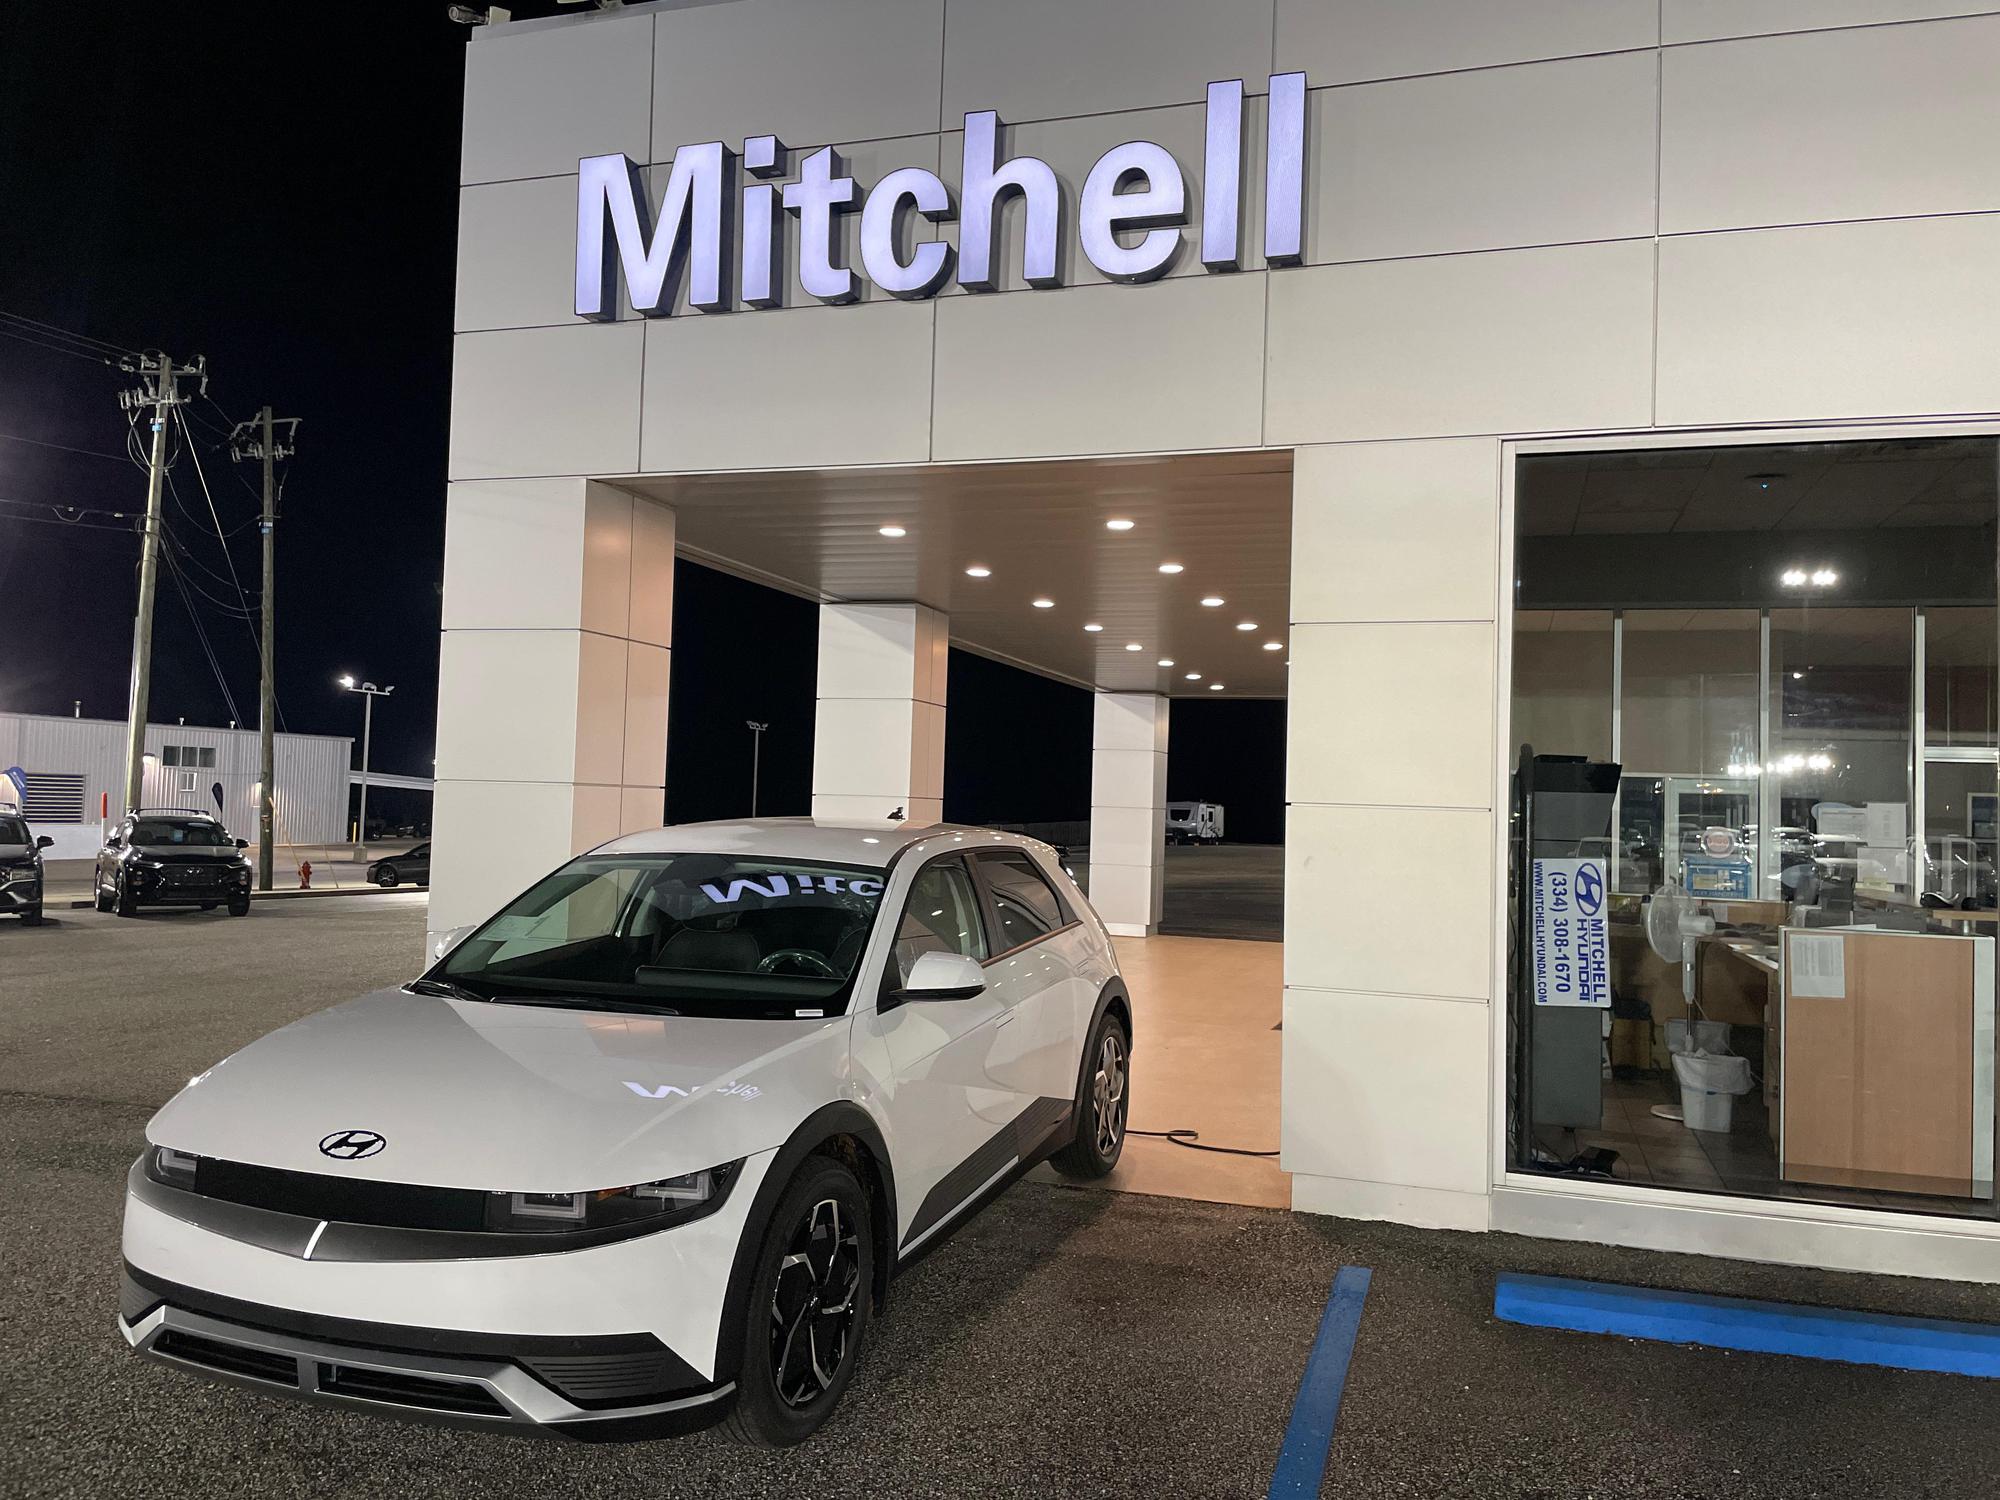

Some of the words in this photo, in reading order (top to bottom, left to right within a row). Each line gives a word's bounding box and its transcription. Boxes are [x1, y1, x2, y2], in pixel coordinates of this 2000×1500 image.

[574, 71, 1308, 319] Mitchell
[1533, 861, 1548, 1003] WWW.MITCHELLHYUNDAI.COM
[1548, 871, 1568, 912] (334)
[1553, 918, 1571, 993] 308-1670
[1576, 918, 1590, 1001] HYUNDAI
[1590, 918, 1607, 1003] MITCHELL
